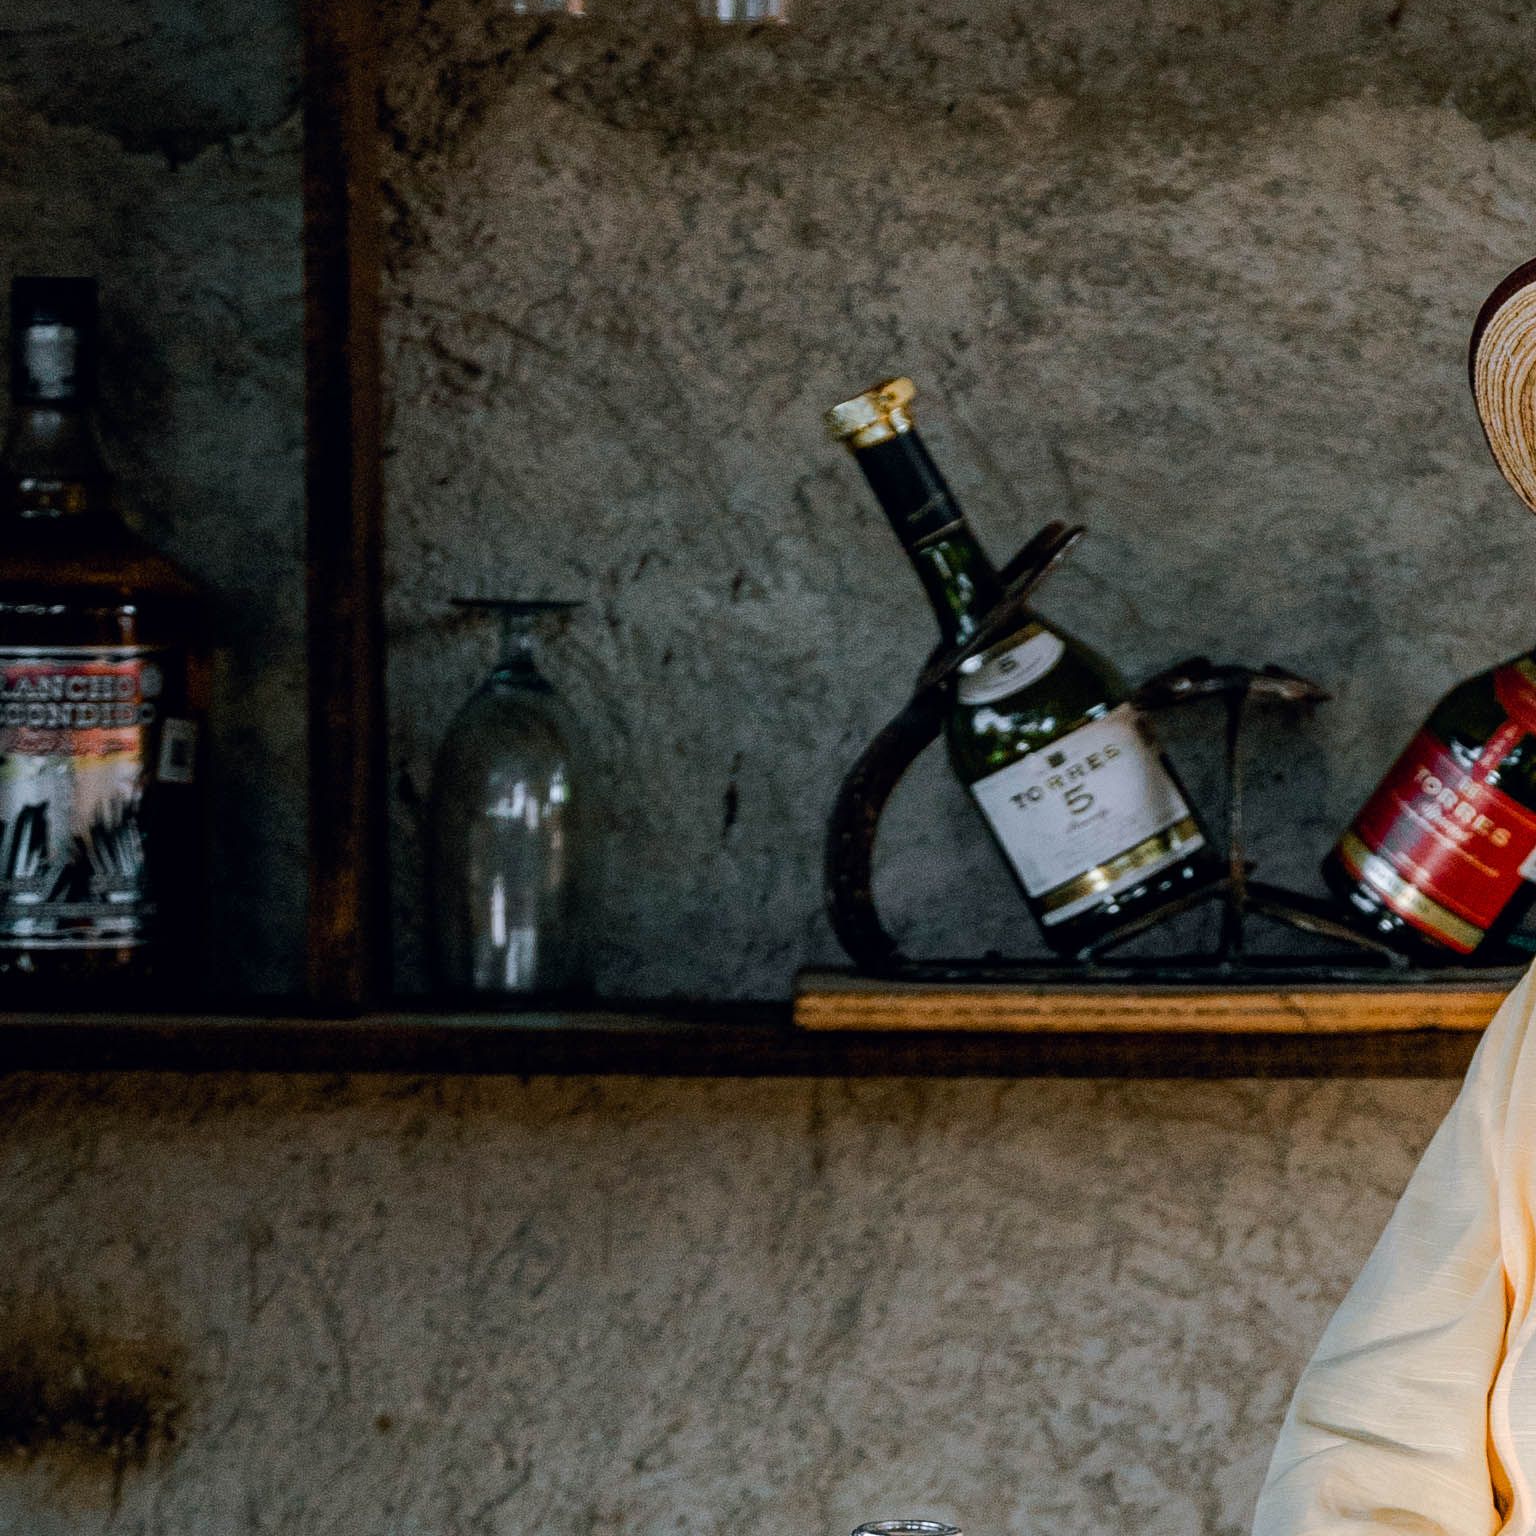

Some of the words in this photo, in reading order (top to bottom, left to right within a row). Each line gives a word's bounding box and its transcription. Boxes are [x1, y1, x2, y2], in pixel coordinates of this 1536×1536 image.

[1010, 743, 1121, 809] TORRES
[1063, 784, 1095, 815] 5
[1413, 764, 1513, 849] TORRES
